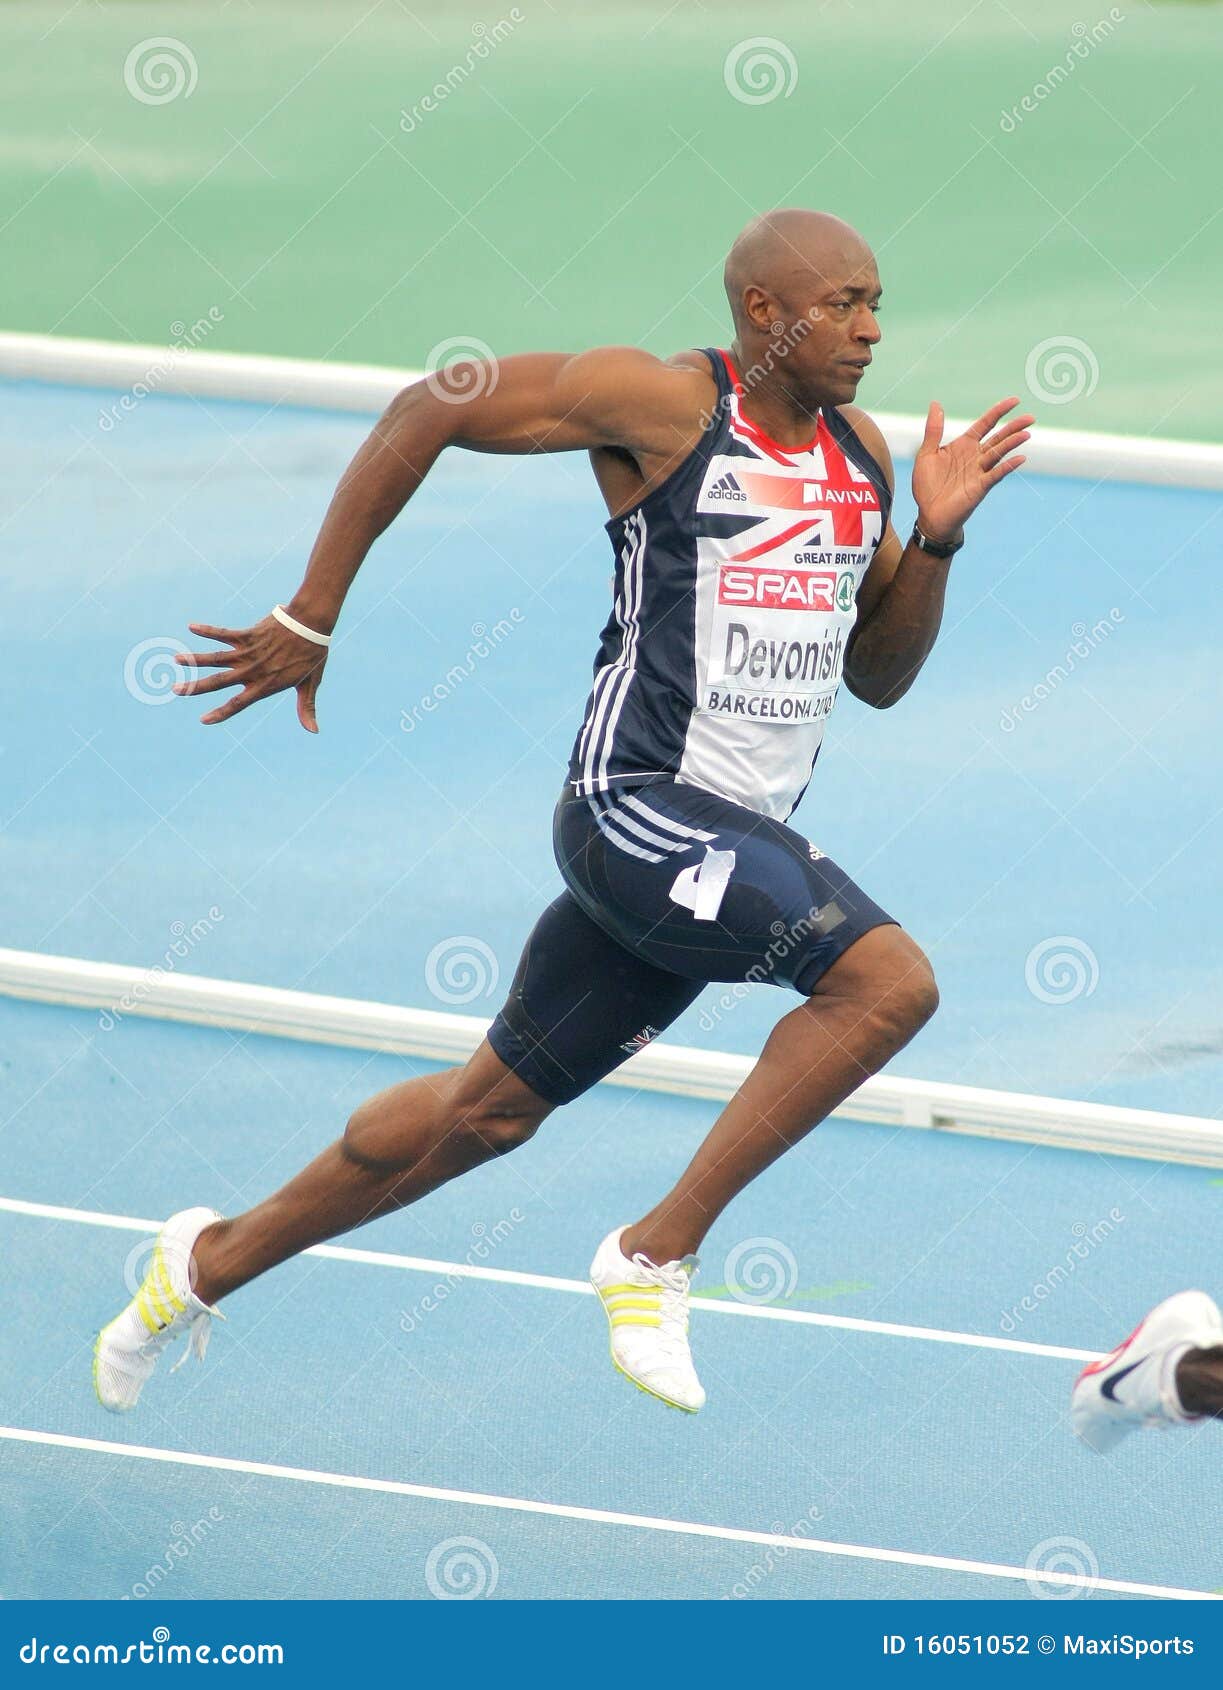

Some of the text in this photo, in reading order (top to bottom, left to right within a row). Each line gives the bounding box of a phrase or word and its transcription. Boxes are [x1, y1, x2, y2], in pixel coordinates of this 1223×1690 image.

[707, 489, 748, 502] adidas
[825, 488, 876, 505] AVIVA
[794, 552, 832, 564] GREAT
[722, 570, 835, 607] SPAR
[723, 622, 842, 681] Devonish
[708, 691, 812, 719] BARCELONA
